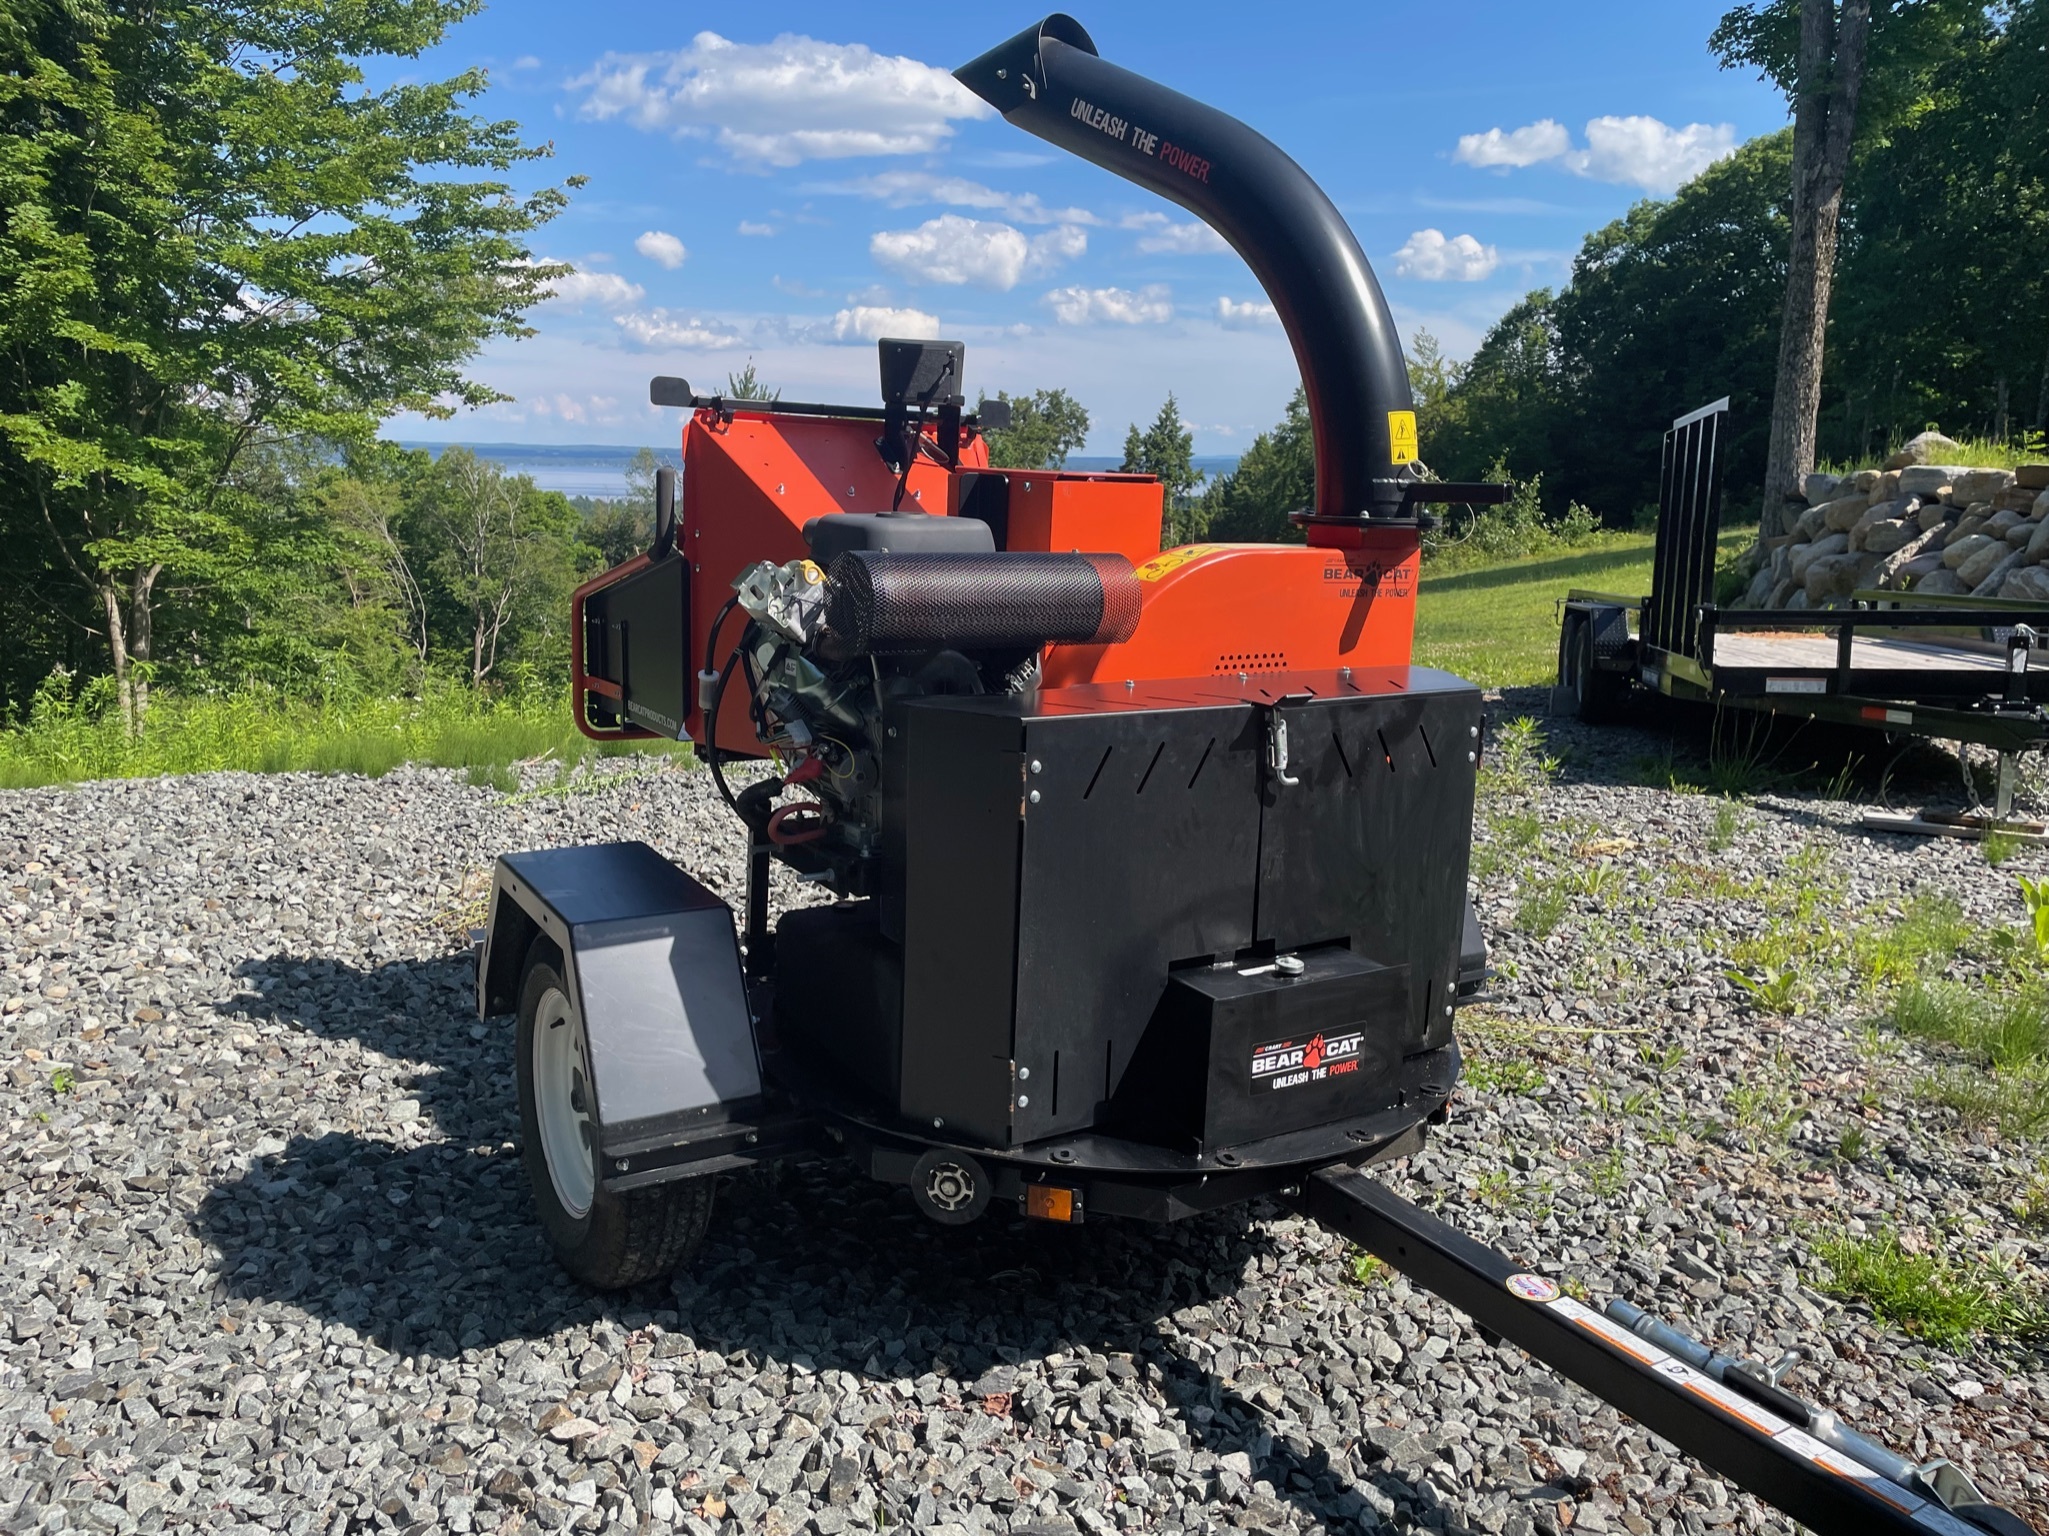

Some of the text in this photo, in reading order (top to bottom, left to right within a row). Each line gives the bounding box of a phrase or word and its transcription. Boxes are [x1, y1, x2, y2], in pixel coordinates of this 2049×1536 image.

[1070, 97, 1128, 141] UNLEASH
[1131, 126, 1158, 156] THE
[1323, 568, 1410, 580] BEAR CAT
[1339, 588, 1368, 598] UNLEASH
[1371, 588, 1382, 598] THE
[1251, 1037, 1361, 1074] BEAR CAT
[1272, 1071, 1309, 1090] UNLEASH
[1311, 1067, 1327, 1081] THE
